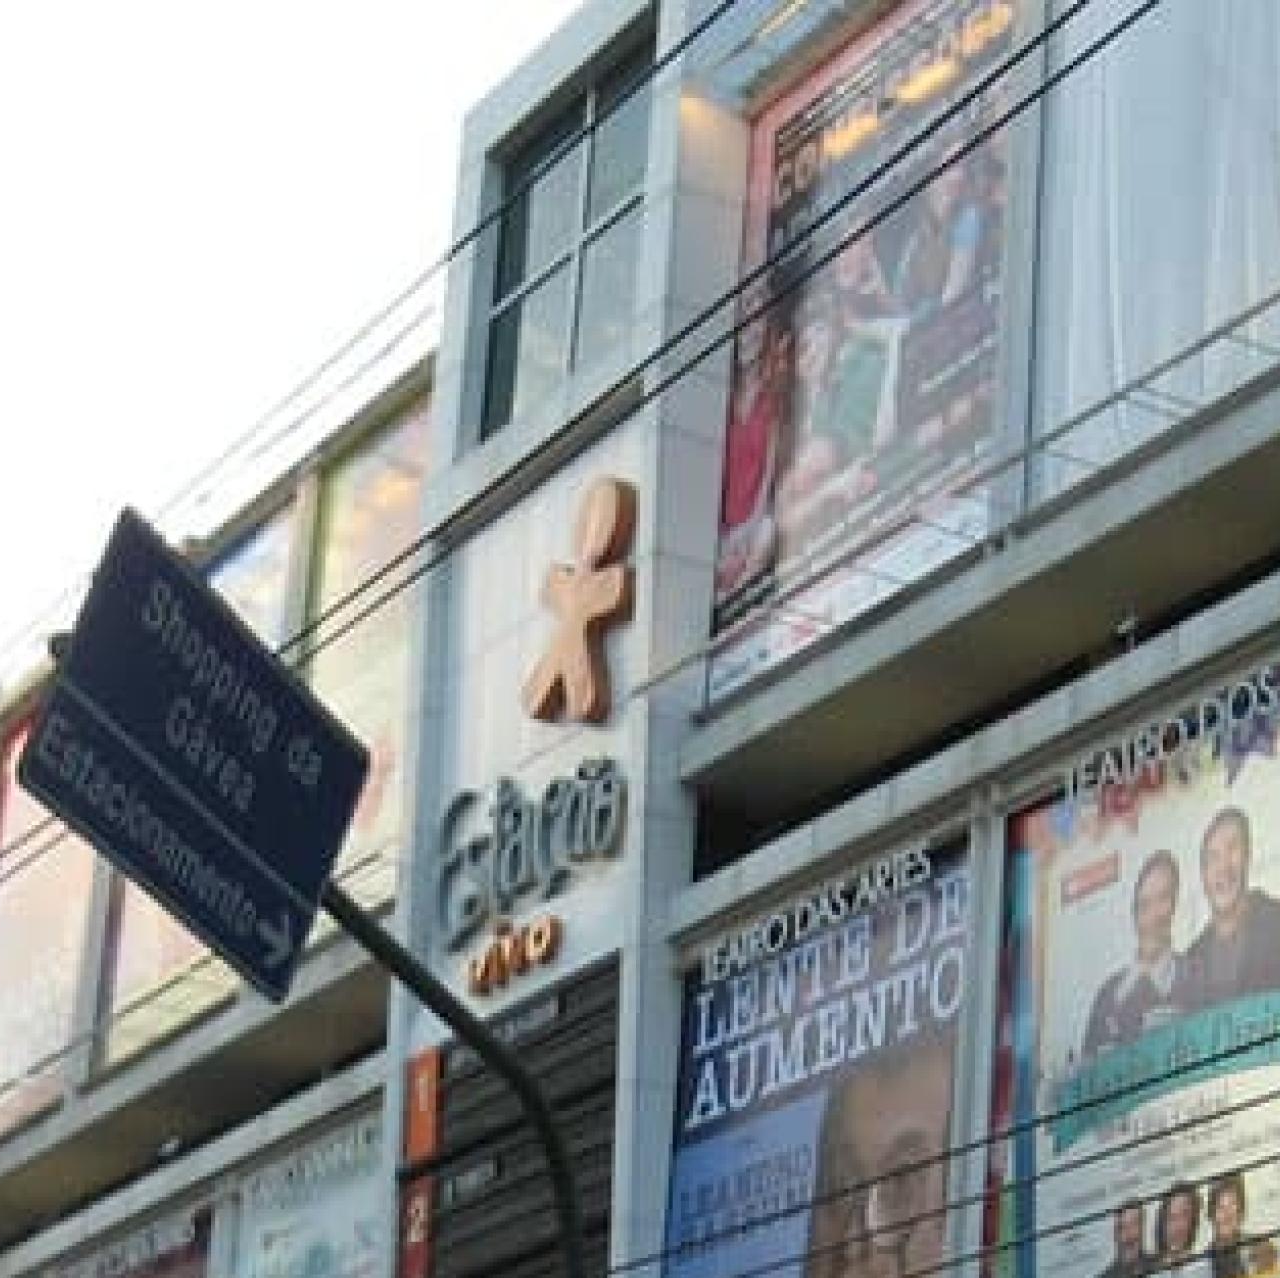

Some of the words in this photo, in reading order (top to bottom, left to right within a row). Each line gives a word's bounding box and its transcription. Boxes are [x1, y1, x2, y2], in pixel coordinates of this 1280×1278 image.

[142, 583, 277, 753] Shopping
[287, 735, 322, 787] da
[165, 694, 258, 813] Gávea
[1065, 721, 1182, 800] TEATRO
[1197, 665, 1279, 733] DOS
[37, 713, 260, 939] Estacionamento
[693, 914, 872, 1058] LENTE
[888, 874, 972, 965] DE
[700, 914, 788, 984] TEATRO
[794, 880, 854, 940] DAS
[856, 847, 932, 906] ARTES
[684, 947, 966, 1129] AUMENTO
[406, 1195, 426, 1244] 2
